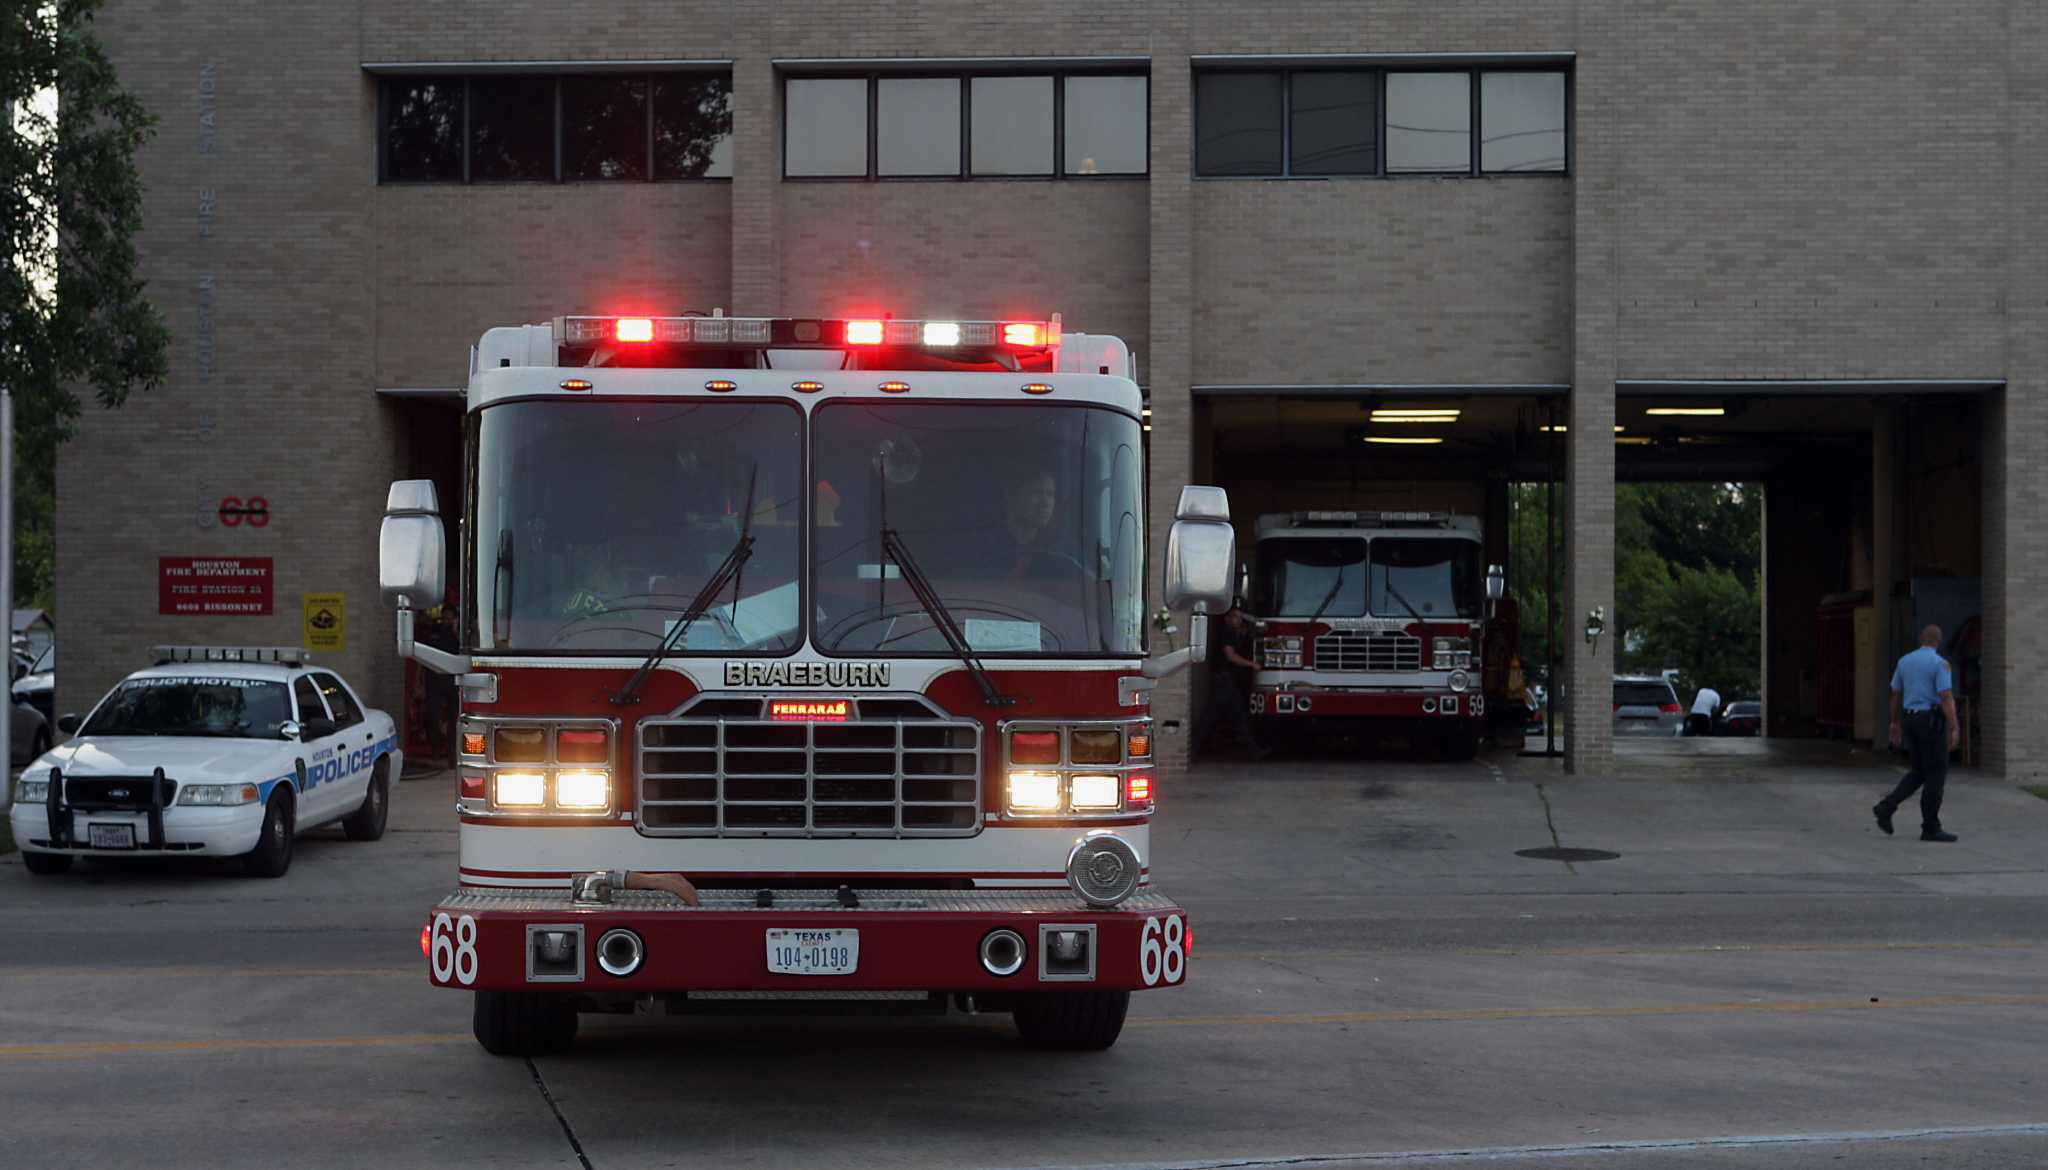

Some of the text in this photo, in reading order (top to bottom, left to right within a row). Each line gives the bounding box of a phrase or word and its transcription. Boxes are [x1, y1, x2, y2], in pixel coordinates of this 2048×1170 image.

[200, 63, 217, 153] STATION
[200, 187, 216, 238] FIRE
[218, 495, 271, 528] 68
[166, 568, 267, 576] FIRE DEPARTMENT
[192, 560, 240, 568] HOUSTON
[172, 585, 198, 593] FIRE
[202, 585, 245, 593] STATION
[724, 661, 890, 687] BRAEBURN
[773, 703, 835, 715] FERRARA
[1250, 693, 1265, 714] 59
[1469, 694, 1485, 716] 59
[314, 747, 371, 786] POLICE
[795, 932, 831, 941] TEXAS
[431, 912, 478, 986] 68
[776, 947, 848, 967] 104 0198
[1140, 914, 1184, 986] 68
